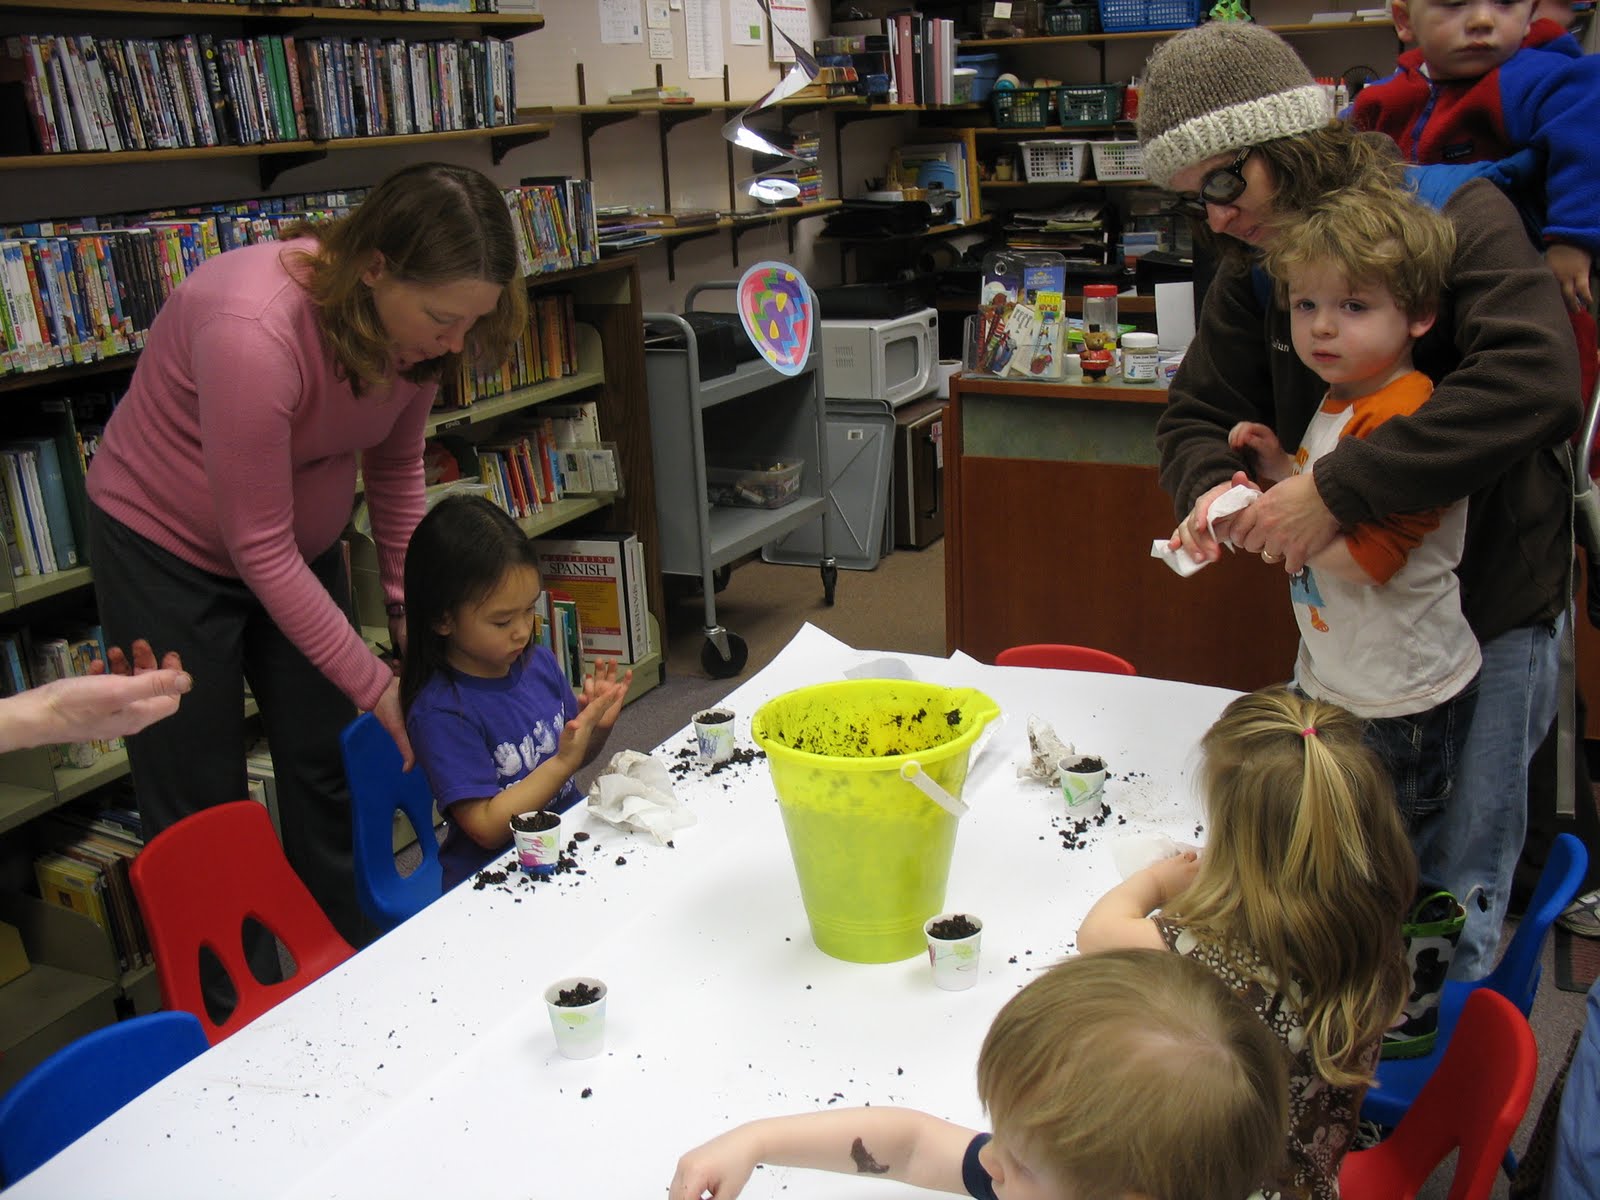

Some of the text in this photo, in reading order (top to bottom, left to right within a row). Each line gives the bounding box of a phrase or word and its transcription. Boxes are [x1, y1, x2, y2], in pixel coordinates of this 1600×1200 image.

[207, 62, 221, 92] U-571
[258, 72, 270, 112] VALKYRIE
[549, 562, 608, 576] SPANISH
